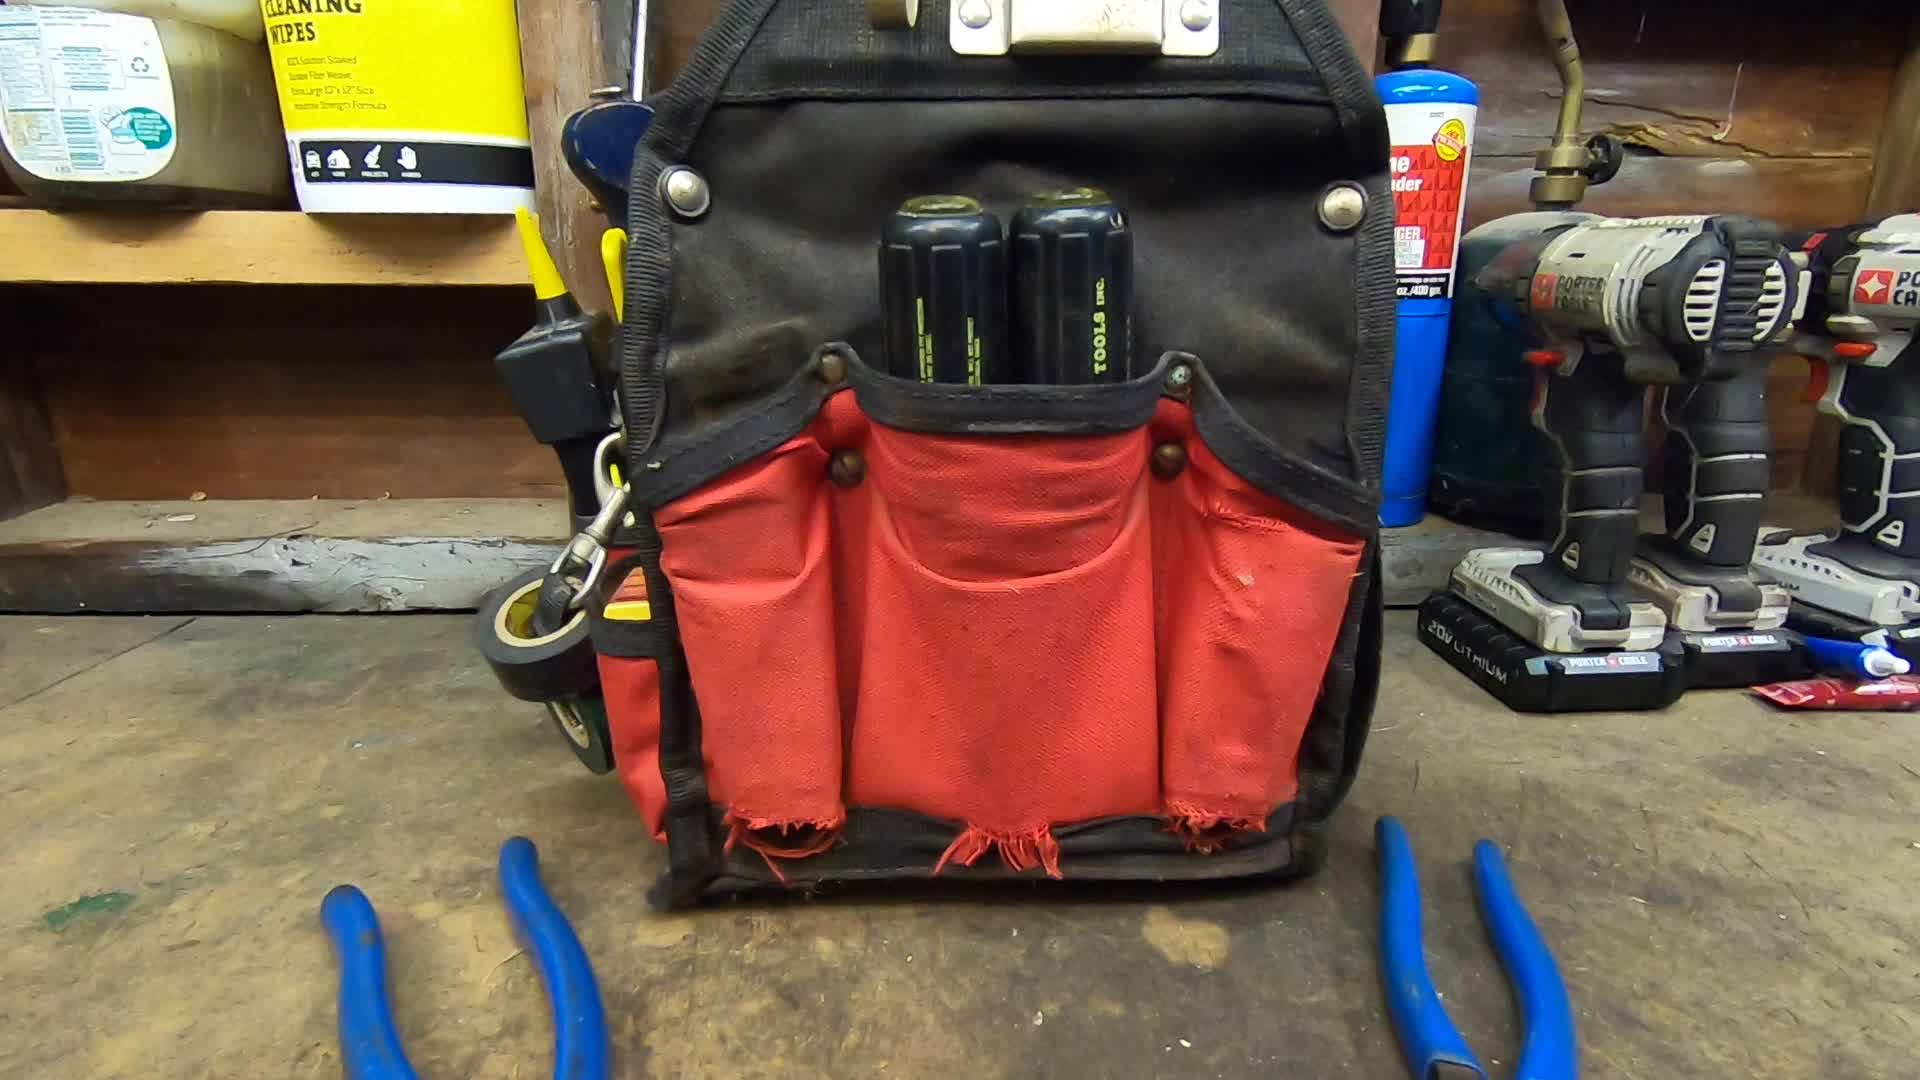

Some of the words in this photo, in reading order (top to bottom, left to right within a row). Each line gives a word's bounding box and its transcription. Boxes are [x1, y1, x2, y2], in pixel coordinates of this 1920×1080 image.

[269, 22, 315, 45] WIPES
[1093, 311, 1107, 375] TOOLS
[1453, 639, 1507, 685] LITHIUM
